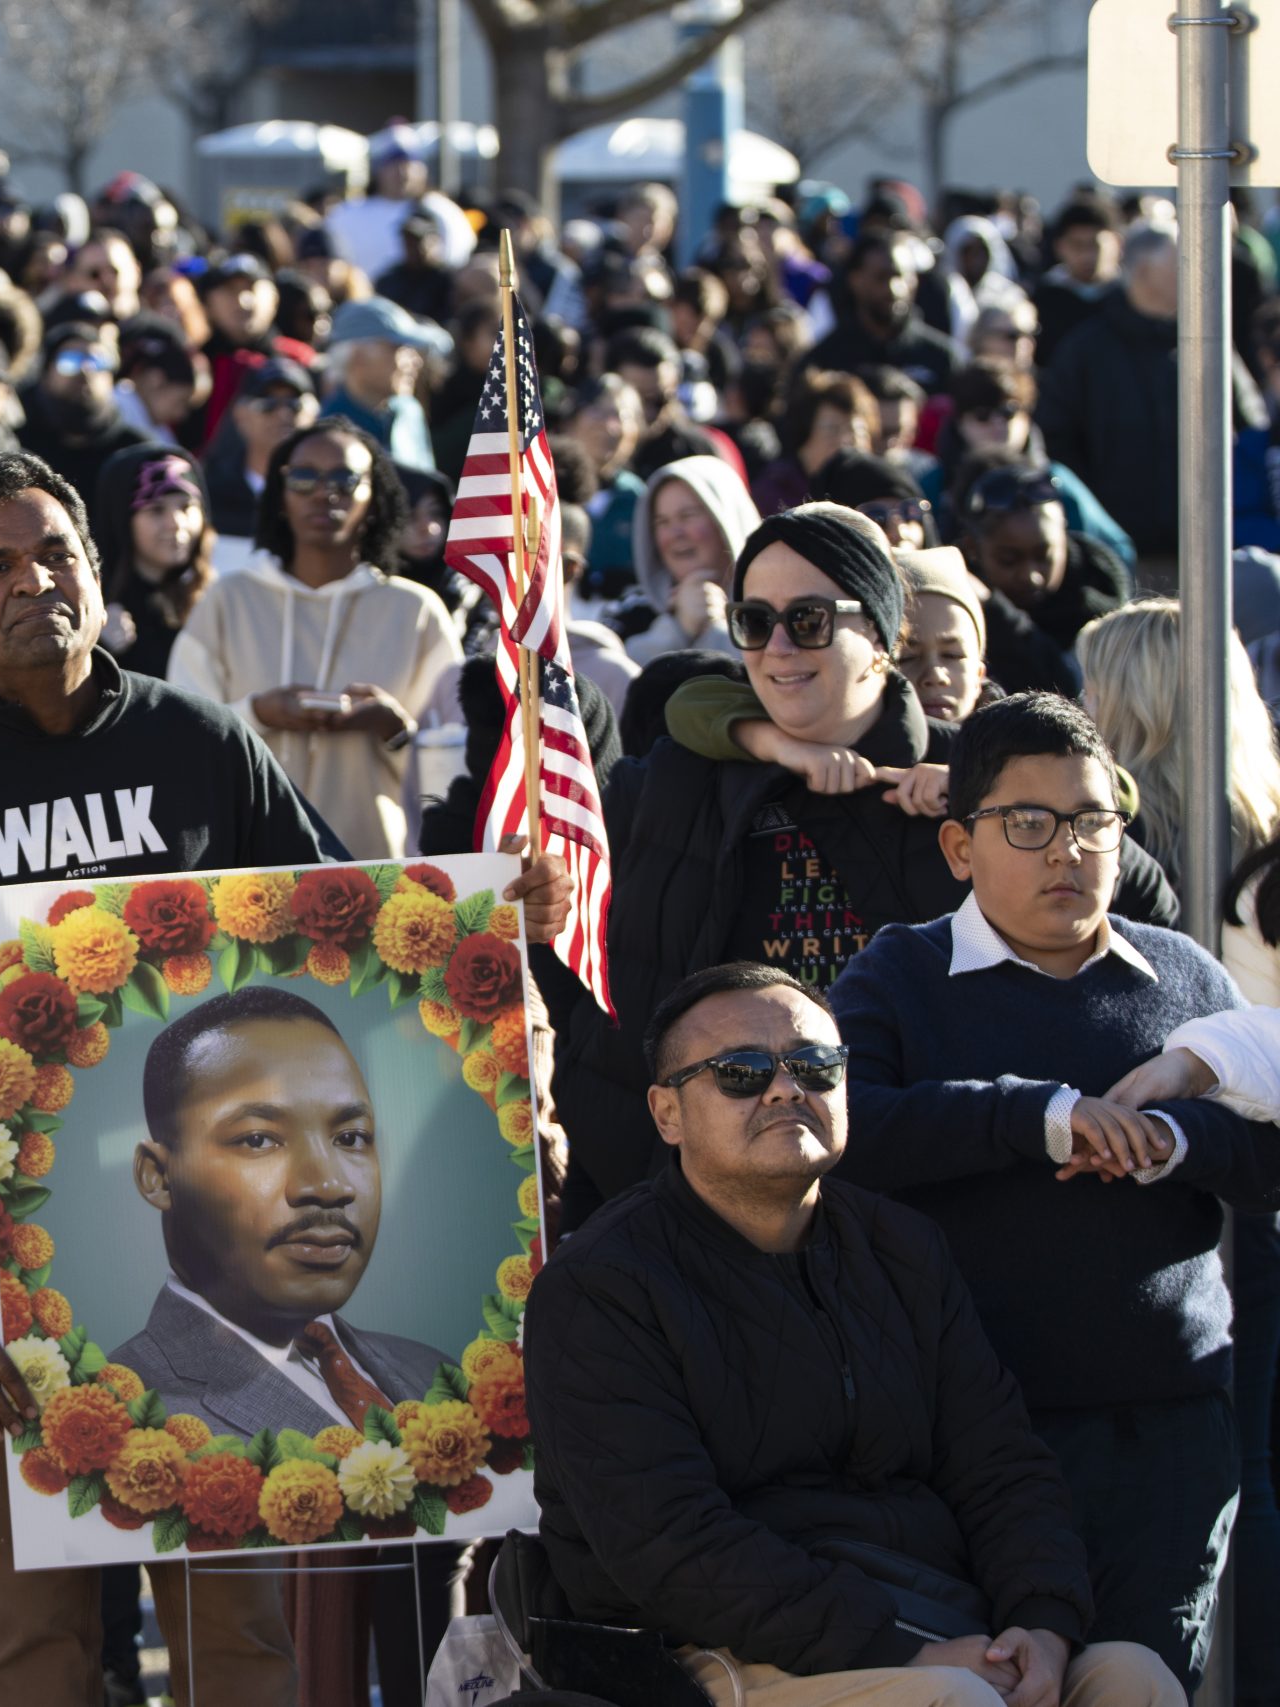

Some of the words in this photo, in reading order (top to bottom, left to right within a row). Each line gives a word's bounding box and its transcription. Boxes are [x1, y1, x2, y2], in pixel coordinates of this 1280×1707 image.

[786, 850, 817, 860] LIKE
[65, 864, 107, 878] ACTION
[781, 878, 812, 888] LIKE
[775, 903, 808, 912] LIKE
[780, 930, 816, 939] LIKE
[823, 926, 868, 937] GARV
[792, 956, 826, 967] LIKE
